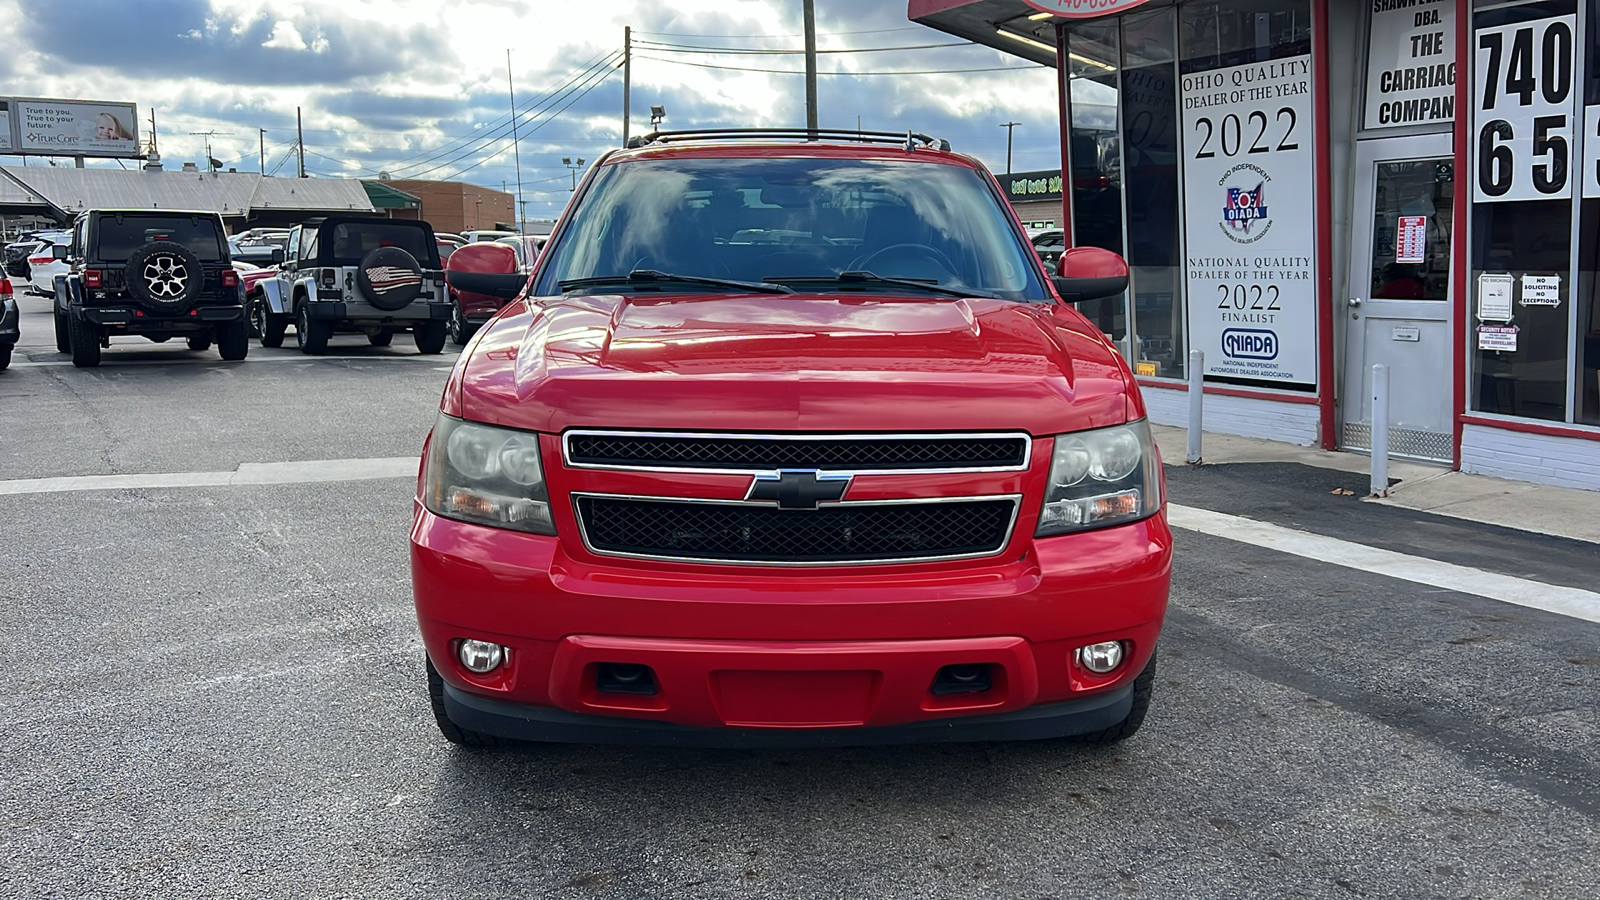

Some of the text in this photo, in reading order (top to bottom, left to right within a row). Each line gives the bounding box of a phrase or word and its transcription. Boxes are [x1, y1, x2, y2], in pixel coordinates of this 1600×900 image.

[1414, 9, 1442, 27] DBA.
[1410, 32, 1444, 58] THE
[1183, 59, 1310, 92] OHIO QUALITY
[1480, 22, 1572, 110] 740
[1185, 81, 1308, 110] DEALER OF THE YEAR
[36, 133, 79, 143] TrueCore
[1195, 106, 1298, 159] 2022
[1219, 163, 1272, 186] OHIO INDEPENDENT
[1228, 208, 1260, 220] OIADA
[1190, 258, 1310, 268] NATIONAL QUALITY
[1190, 271, 1309, 280] DEALER OF THE YEAR
[1218, 284, 1280, 310] 2022
[1222, 313, 1275, 323] FINALIST
[1226, 334, 1272, 354] NIADA
